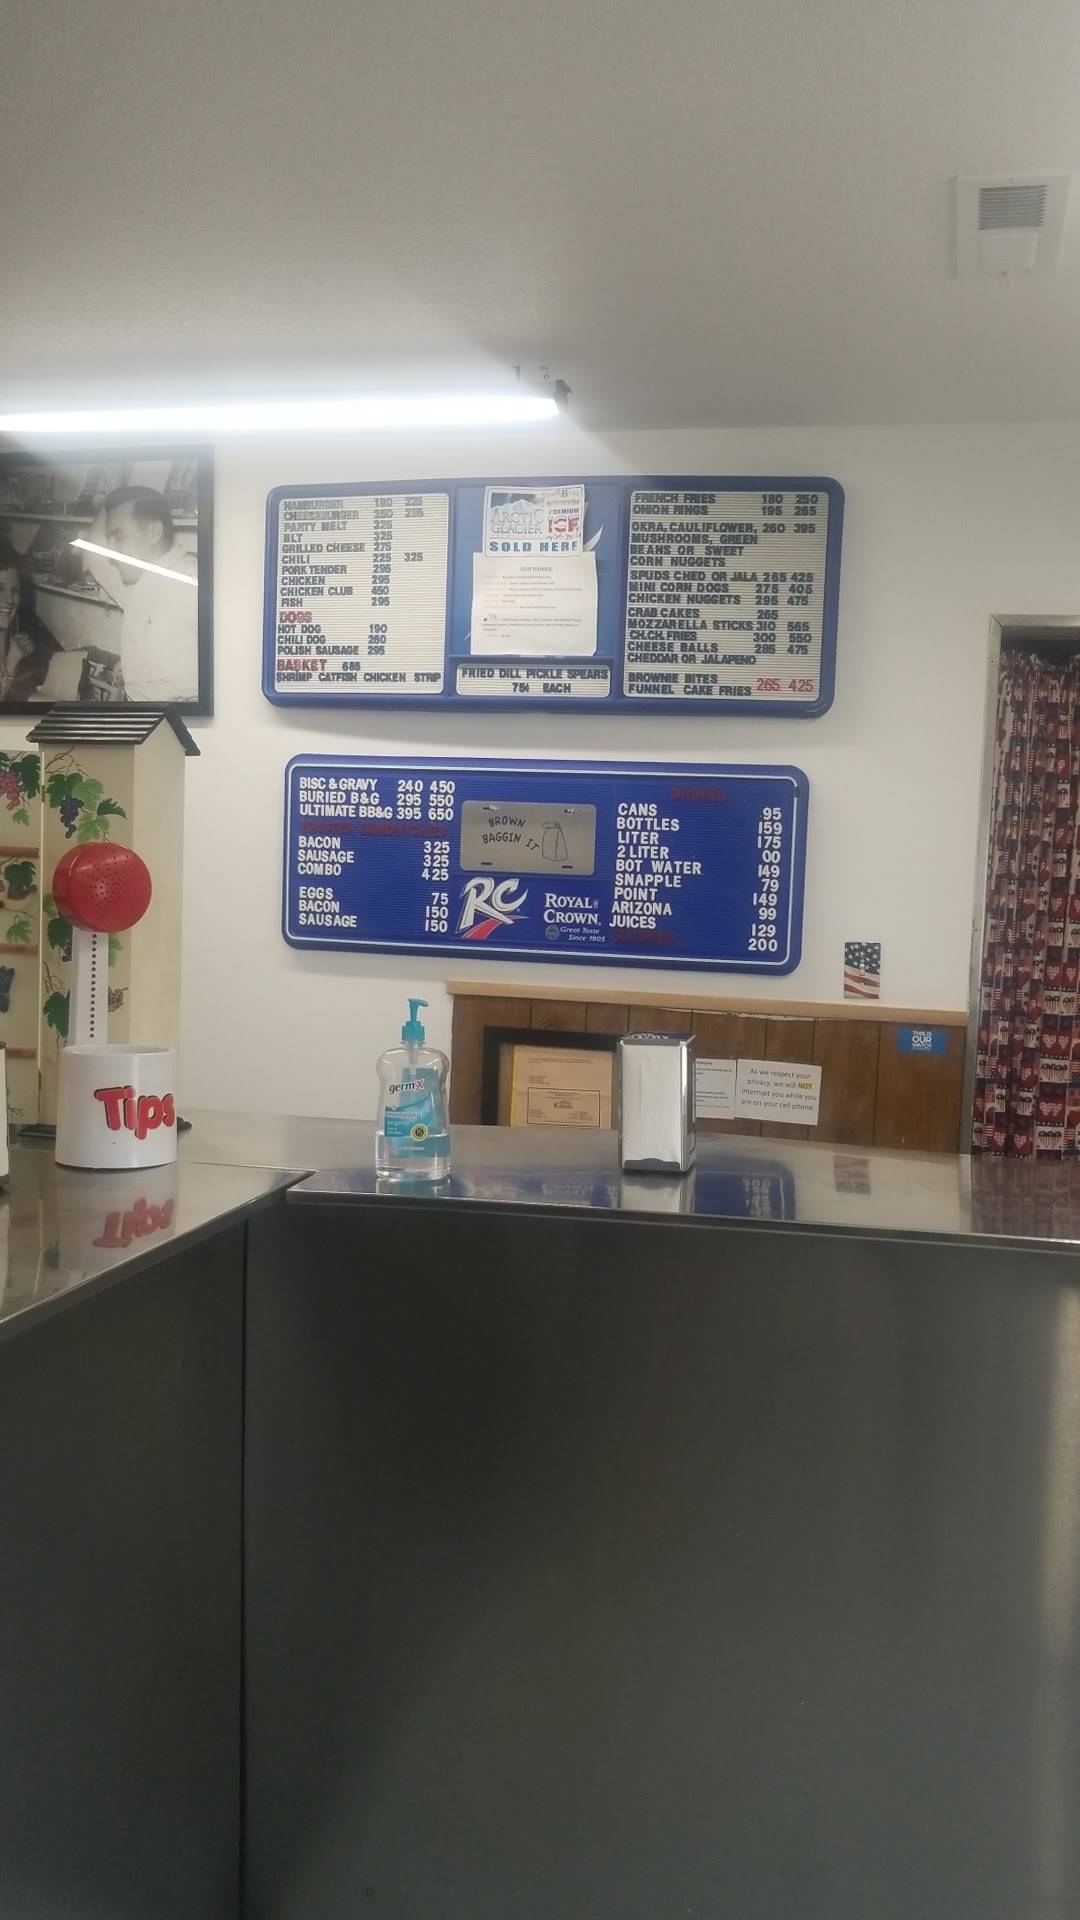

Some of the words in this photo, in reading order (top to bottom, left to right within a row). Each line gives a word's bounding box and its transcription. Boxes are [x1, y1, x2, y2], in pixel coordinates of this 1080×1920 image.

[634, 493, 678, 503] FRENCH
[684, 494, 716, 504] FRIES
[491, 508, 544, 524] ARCTIC
[633, 505, 670, 514] ONION
[673, 506, 708, 515] RINGS
[321, 521, 348, 531] MELT
[491, 523, 543, 534] GLACIER
[283, 534, 303, 543] BLT
[632, 534, 713, 545] MUSHROOMS,
[720, 534, 758, 544] GREEN
[282, 544, 324, 554] GRILLED
[326, 543, 366, 552] CHEESE
[490, 542, 532, 552] SOLD
[630, 545, 670, 555] BEANS
[677, 546, 694, 555] OR
[704, 546, 744, 556] SWEET
[282, 555, 311, 565] CHILI
[630, 556, 662, 566] CORN
[670, 557, 726, 567] NUGGETS
[282, 566, 307, 575] PORK
[308, 565, 348, 574] TENDER
[630, 570, 670, 580] SPUDS
[674, 571, 706, 581] CHED
[712, 571, 728, 582] OR
[730, 572, 758, 582] JALA
[790, 572, 814, 582] 425
[281, 576, 326, 586] CHICKEN
[280, 587, 324, 596] CHICKEN
[328, 586, 354, 596] CLUB
[629, 582, 656, 592] MINI
[660, 582, 692, 592] CORN
[697, 583, 729, 592] DOGS
[755, 584, 778, 594] 275
[281, 598, 303, 607] FISH
[628, 594, 681, 604] CHICKEN
[687, 594, 741, 604] NUGGETS
[279, 610, 312, 623] DOGS
[628, 608, 657, 618] CRAB
[660, 608, 700, 618] CAKES
[278, 625, 296, 634] HOT
[301, 625, 321, 634] DOG
[628, 619, 707, 630] MOZZARELLA
[712, 620, 756, 631] STICKS
[278, 635, 303, 644] CHILI
[306, 635, 326, 644] DOG
[753, 632, 776, 642] 300
[278, 646, 312, 656] POLISH
[316, 646, 360, 656] SAUSAGE
[628, 642, 674, 652] CHEESE
[680, 642, 718, 652] BALLS
[276, 658, 328, 672] BASKET
[628, 654, 678, 664] CHEDDAR
[682, 654, 696, 664] OR
[701, 655, 756, 665] JALAPENO
[276, 672, 312, 682] SHRIMP
[318, 672, 358, 682] CATFISH
[364, 672, 406, 682] CHICKEN
[414, 672, 442, 682] STRIP
[462, 668, 494, 678] FRIED
[500, 668, 521, 678] DILL
[526, 668, 562, 679] PICKLE
[566, 669, 609, 680] SPEARS
[543, 683, 572, 693] EACH
[628, 672, 678, 683] BROWNIE
[685, 674, 718, 684] BITES
[756, 678, 780, 692] 265
[788, 678, 814, 692] 425
[628, 684, 674, 694] FUNNEL
[684, 685, 713, 696] CAKE
[719, 686, 752, 696] FRIES
[300, 777, 326, 790] BISC
[328, 778, 338, 790] &
[339, 778, 378, 790] GRAVY
[398, 780, 424, 792] 240
[430, 780, 456, 794] 450
[300, 790, 346, 804] BURIED
[351, 792, 380, 805] B&G
[397, 794, 422, 806] 295
[428, 794, 454, 808] 550
[300, 804, 356, 818] ULTIMATE
[359, 806, 392, 819] BB&G
[397, 808, 422, 820] 395
[428, 808, 454, 820] 650
[618, 803, 658, 816] CANS
[762, 807, 782, 820] 95
[488, 816, 526, 828] BROWN
[616, 817, 680, 832] BOTTLES
[482, 832, 522, 844] BAGGIN
[526, 838, 540, 850] IT
[618, 831, 659, 844] LITER
[299, 836, 341, 849] BACON
[424, 841, 450, 854] 325
[617, 846, 626, 858] 2
[630, 846, 669, 859] LITER
[298, 850, 354, 863] SAUSAGE
[424, 855, 450, 868] 325
[298, 862, 342, 876] COMBO
[422, 868, 449, 881] 425
[616, 860, 643, 872] BOT
[652, 861, 702, 874] WATER
[615, 873, 682, 888] SNAPPLE
[761, 879, 779, 892] 79
[300, 886, 334, 900] EGGS
[432, 892, 448, 906] 75
[614, 887, 658, 901] POINT
[300, 900, 340, 913] BACON
[455, 877, 529, 934] RC
[544, 893, 593, 908] ROYAL
[612, 901, 672, 916] ARIZONA
[759, 908, 777, 920] 99
[299, 913, 358, 928] SAUSAGE
[544, 909, 598, 925] CROWN
[609, 915, 656, 929] JUICES
[560, 926, 580, 934] Great
[748, 938, 778, 952] 200
[770, 1070, 795, 1079] respect
[94, 1085, 176, 1140] Tips
